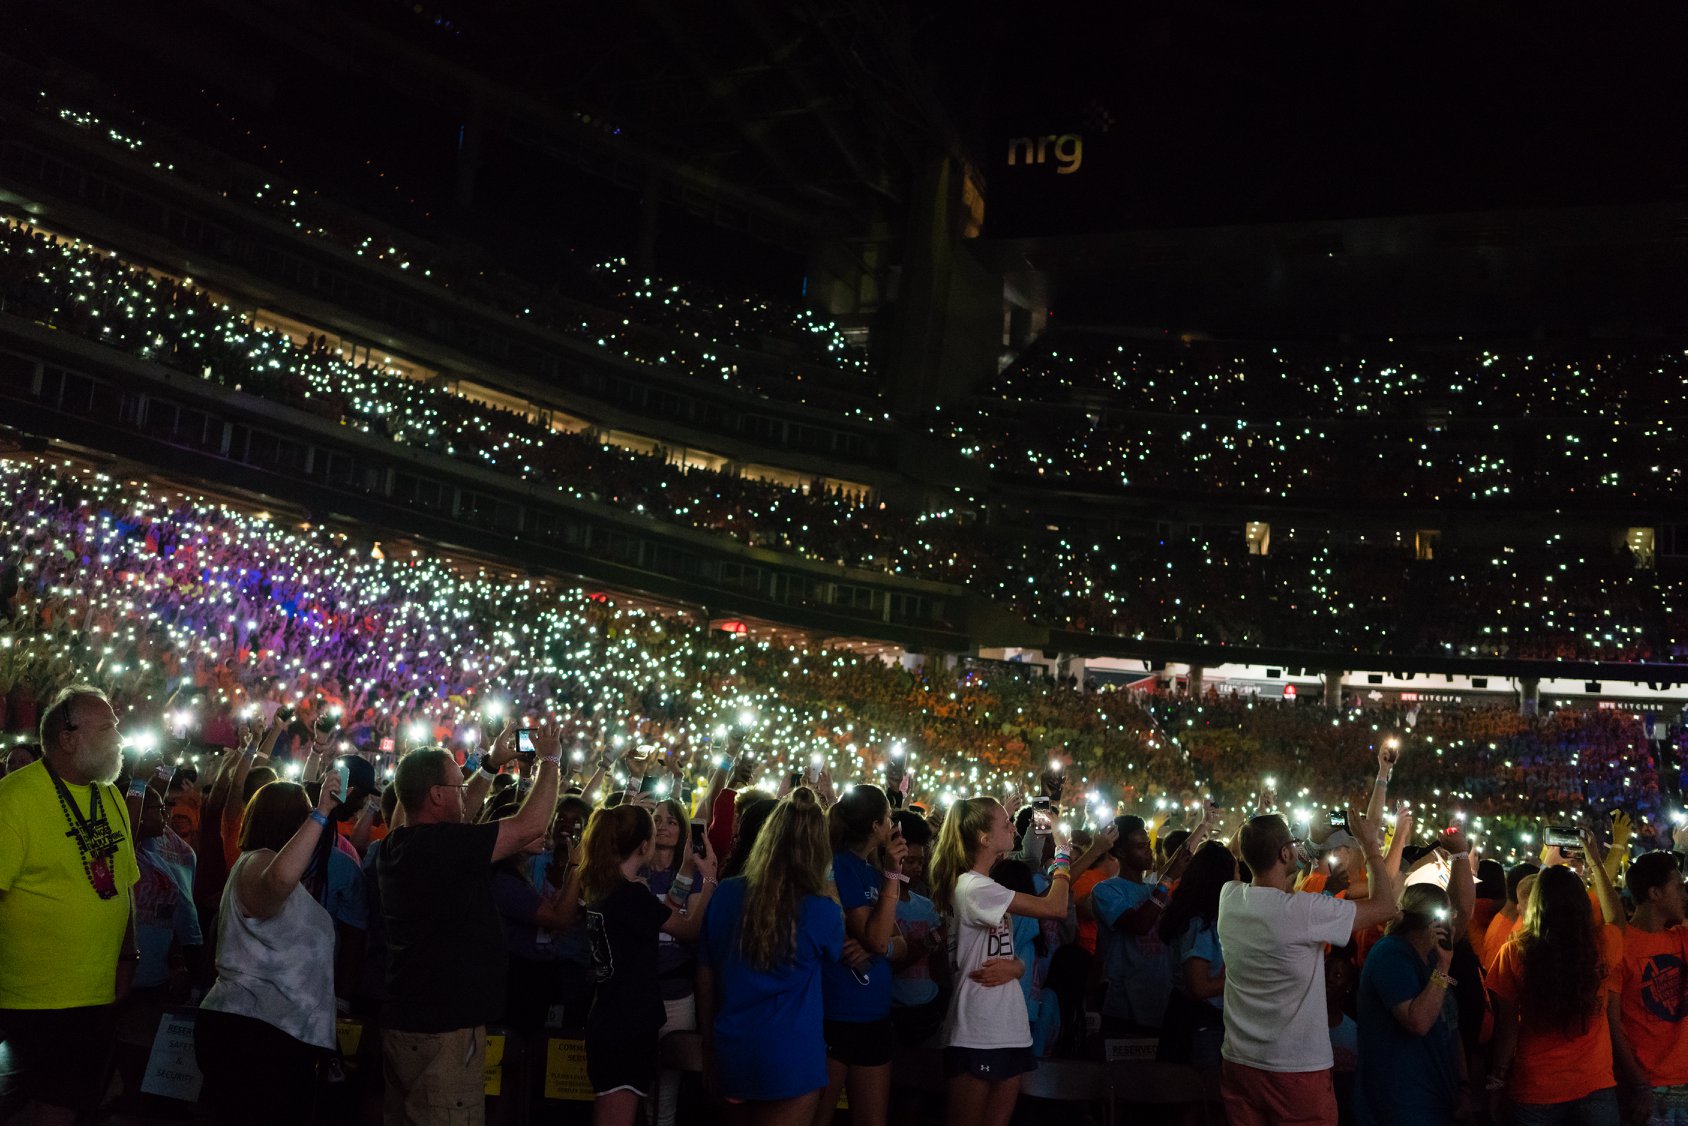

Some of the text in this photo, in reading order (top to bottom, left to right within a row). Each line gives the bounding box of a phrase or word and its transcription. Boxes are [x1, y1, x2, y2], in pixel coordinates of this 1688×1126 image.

[1007, 133, 1083, 174] nrg
[1419, 694, 1462, 703] KITCHEN
[1617, 702, 1664, 711] KITCHEN
[168, 1039, 193, 1050] SAFET
[156, 1069, 194, 1082] SECURITY
